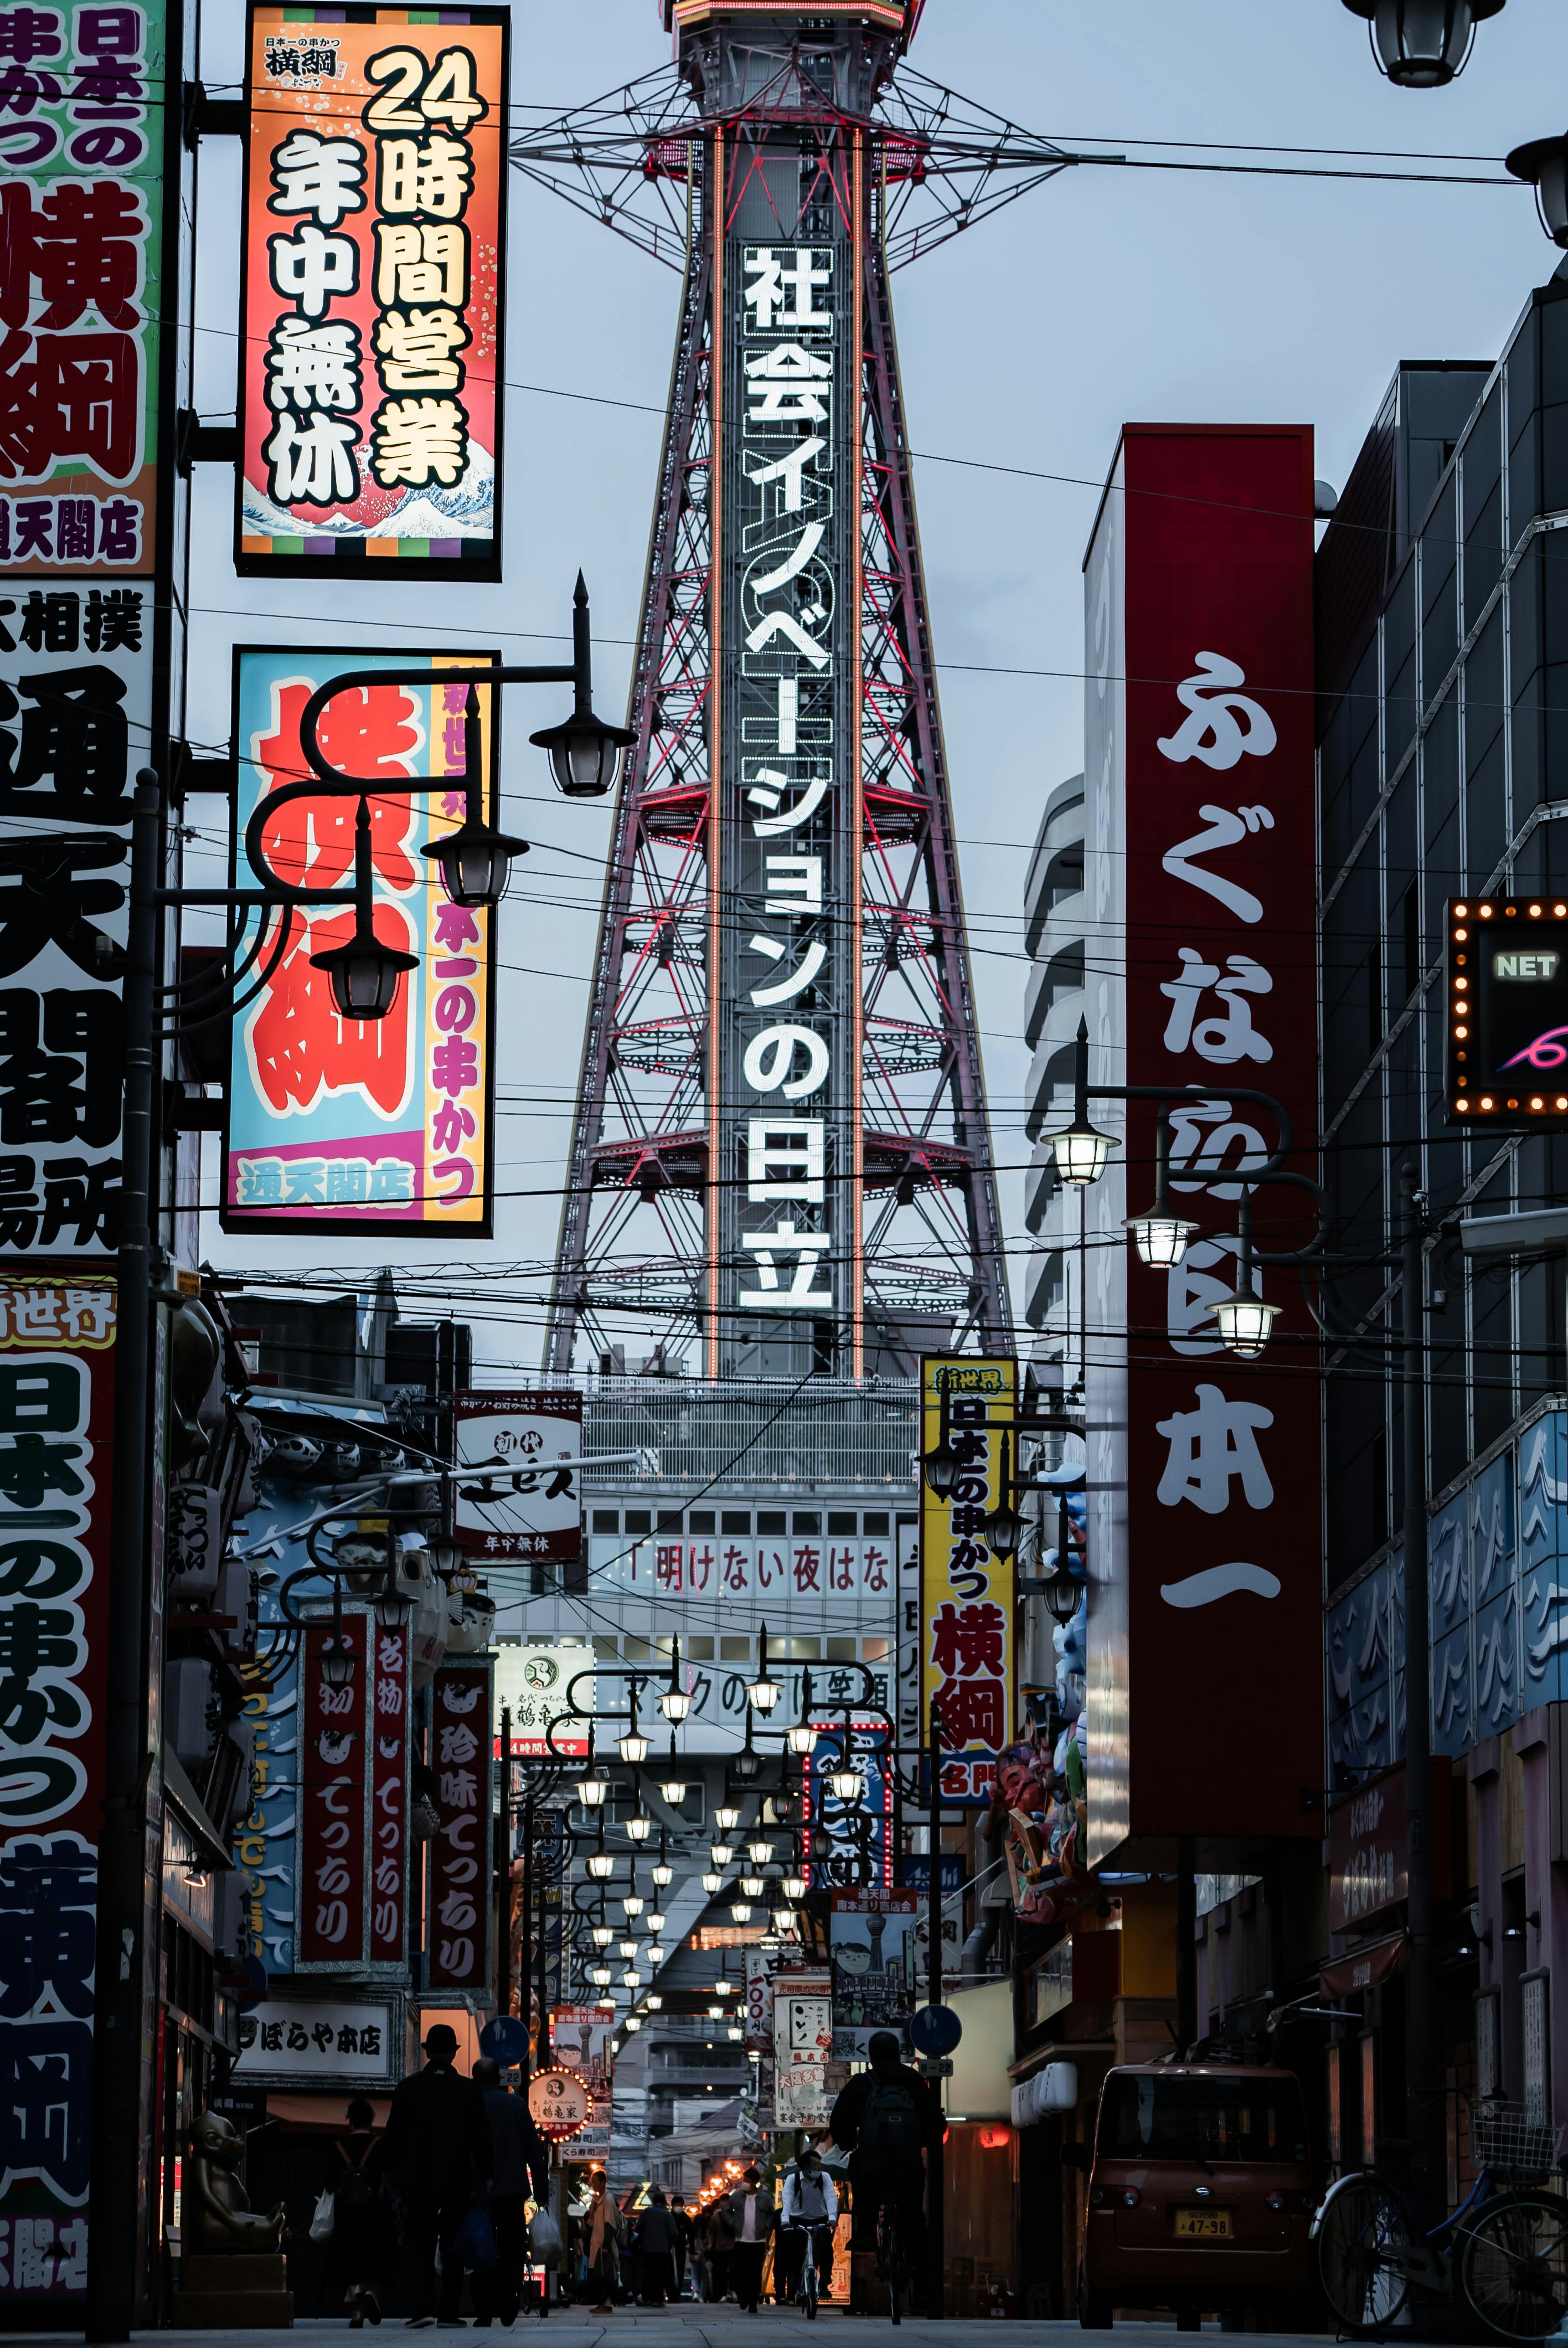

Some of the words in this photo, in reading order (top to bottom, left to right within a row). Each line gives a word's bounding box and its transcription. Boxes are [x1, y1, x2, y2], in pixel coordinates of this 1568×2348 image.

[265, 48, 337, 76] 横綱
[266, 38, 341, 47] 日本一の串かつ
[367, 51, 483, 485] 24時間営業
[270, 135, 363, 501] 年中無休
[0, 499, 139, 560] 天閣店
[0, 589, 143, 653] 相撲
[740, 247, 833, 1308] 社会イノベーションの日立
[247, 682, 419, 1115] 横綱
[1497, 956, 1556, 977] NET
[434, 834, 479, 1207] 本一の串かつ
[1156, 650, 1281, 1609] ふぐなら日本一
[240, 1161, 412, 1207] 通天閣店
[0, 1287, 117, 1340] 世界
[950, 1399, 988, 1599] 日本一の串かつ
[483, 1535, 550, 1553] 年中無休
[624, 1671, 889, 1716] マクのは笑顔
[933, 1605, 1004, 1753] 横綱
[509, 1742, 577, 1755] 4時間営業中
[315, 1775, 351, 1944] てっちり
[374, 1777, 400, 1944] てっちり
[437, 1722, 478, 1978] 珍味てっちり
[905, 1866, 958, 1887] Ashi
[0, 2218, 88, 2289] 閣店
[1188, 2220, 1226, 2234] 47-98
